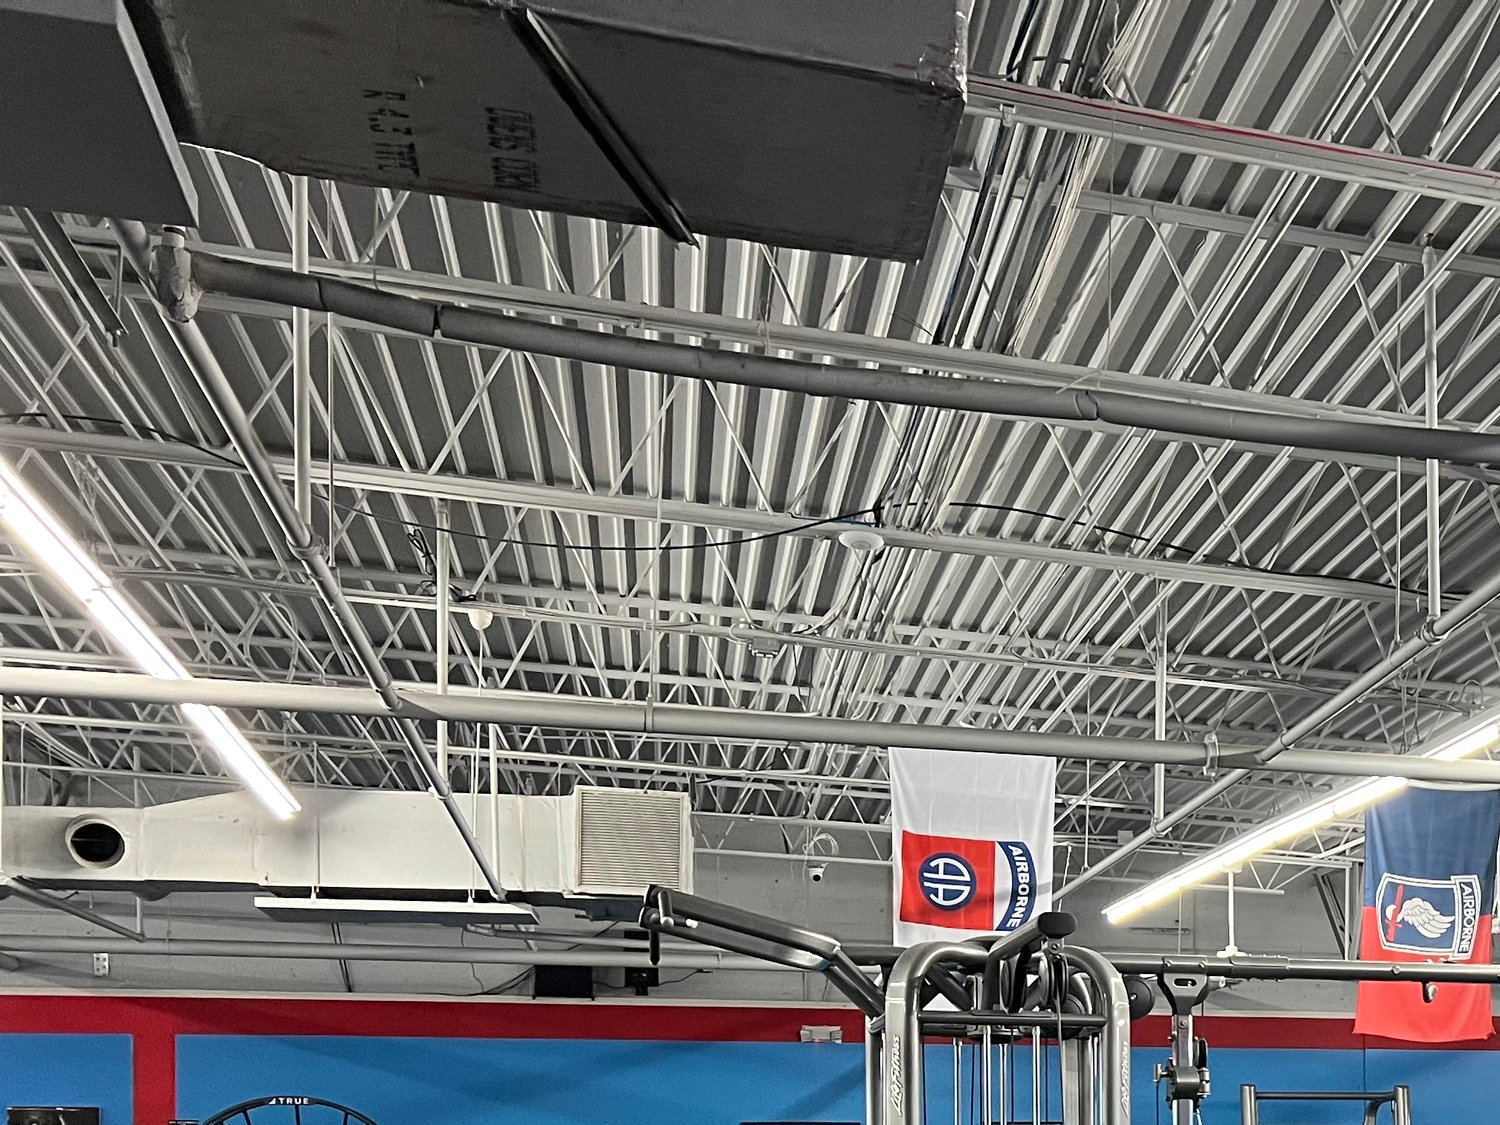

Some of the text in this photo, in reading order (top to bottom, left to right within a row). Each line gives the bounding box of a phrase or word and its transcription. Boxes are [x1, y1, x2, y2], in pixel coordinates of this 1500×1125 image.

[1006, 845, 1029, 928] AIRBORNE
[1460, 883, 1476, 952] AIRBORNE
[278, 1097, 309, 1105] TRUE
